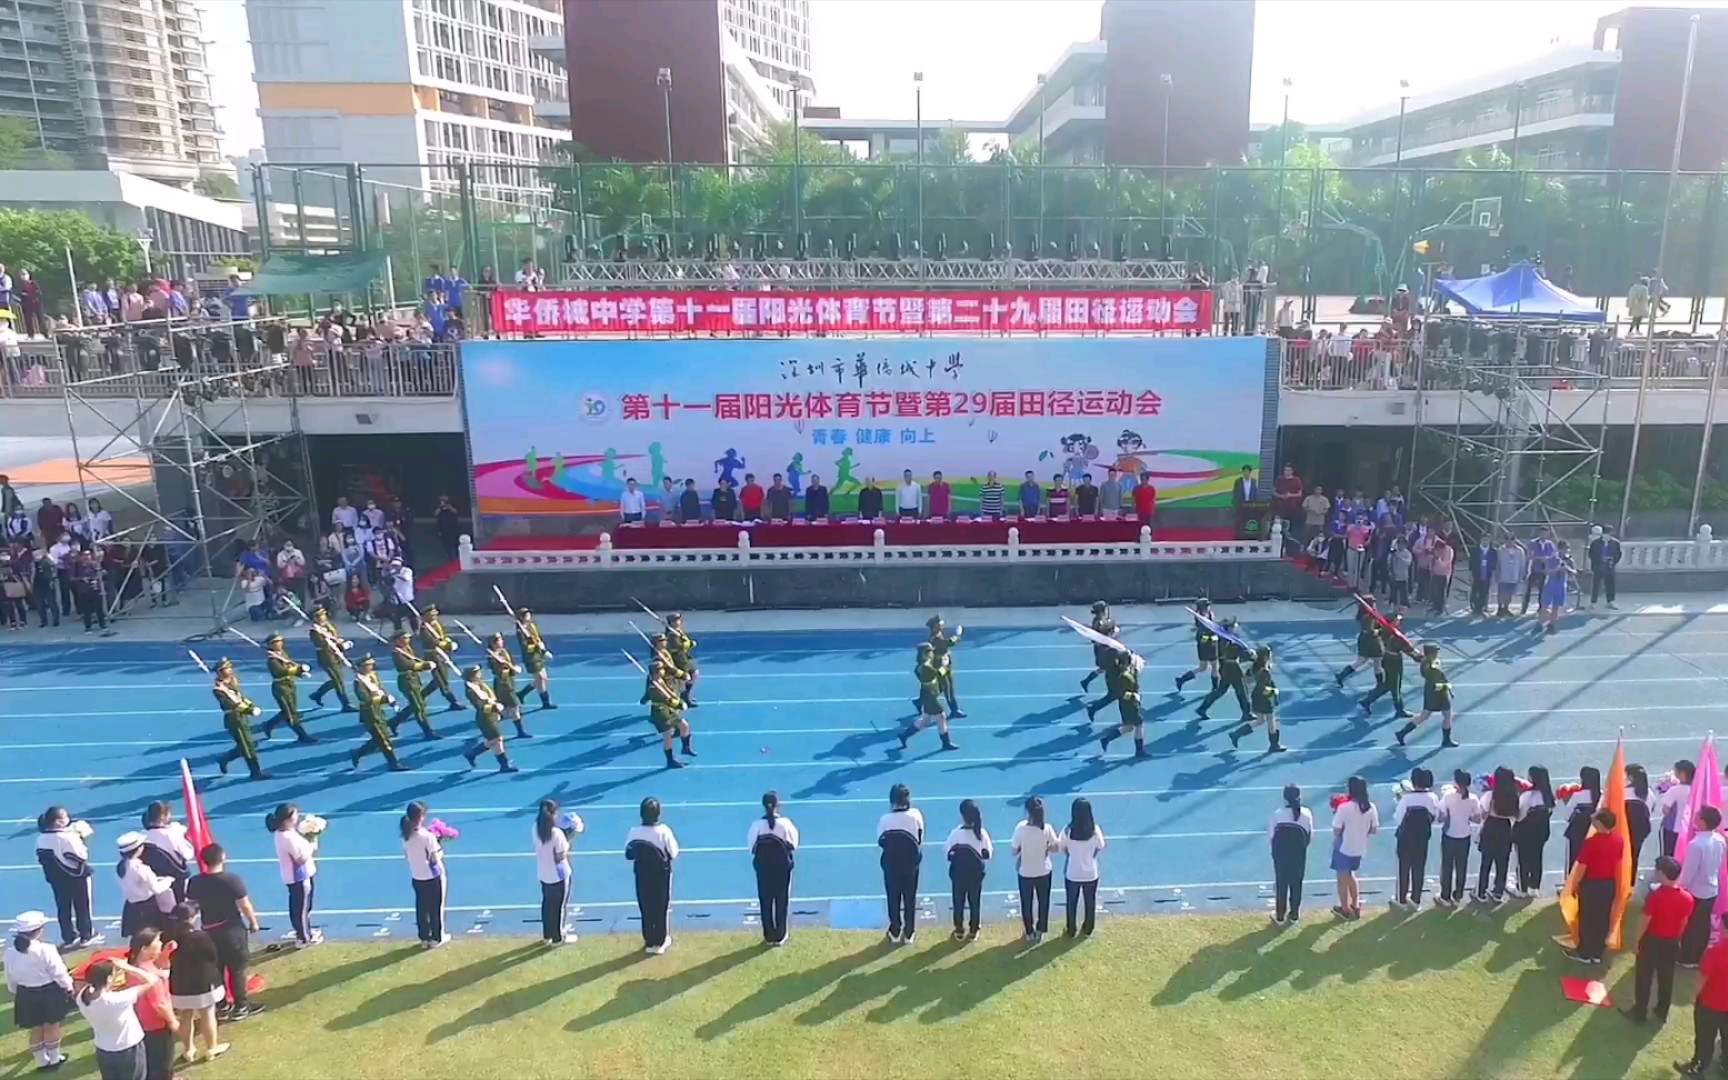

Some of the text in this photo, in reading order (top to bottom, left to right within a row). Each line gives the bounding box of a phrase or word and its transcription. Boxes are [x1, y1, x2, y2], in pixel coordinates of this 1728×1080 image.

[504, 296, 1198, 326] 华侨城中学第十一届阳光体育节暨第二十九届田径运动会
[621, 390, 1162, 420] 第十一届阳光体育节暨第29届田径运动会
[812, 427, 936, 445] 青春 健康 向上
